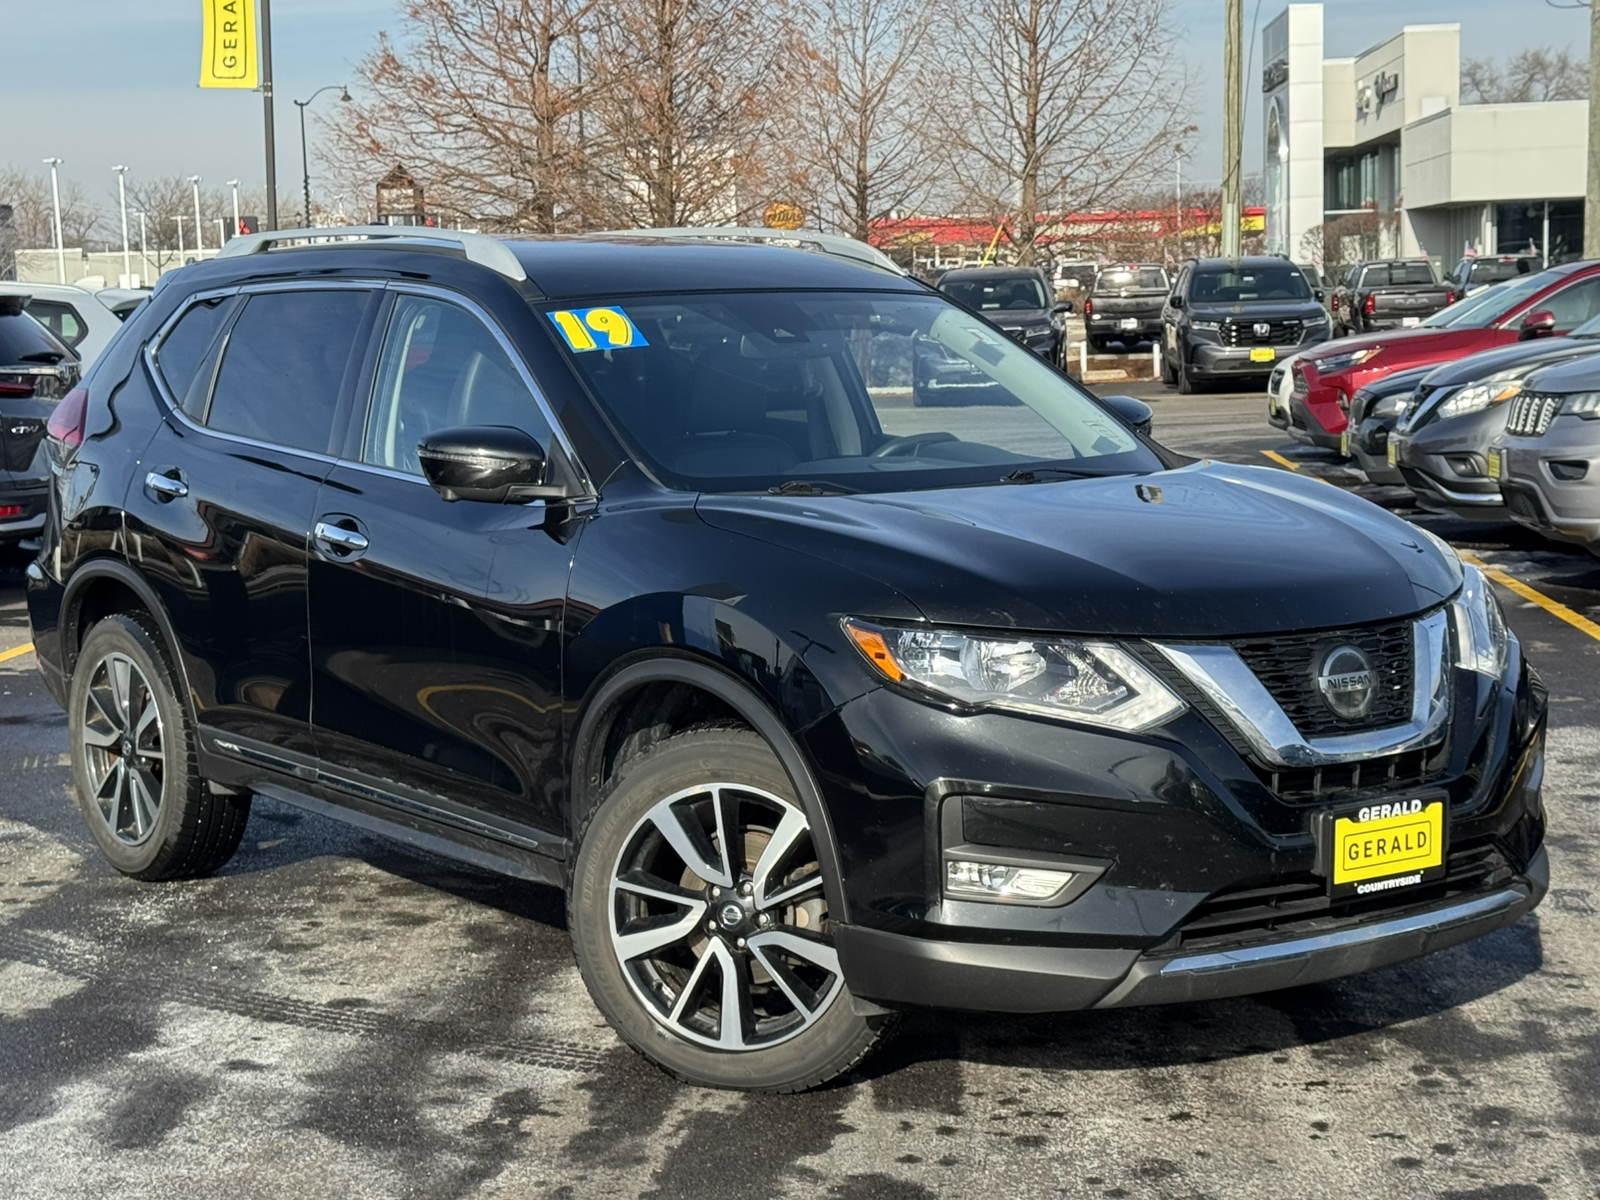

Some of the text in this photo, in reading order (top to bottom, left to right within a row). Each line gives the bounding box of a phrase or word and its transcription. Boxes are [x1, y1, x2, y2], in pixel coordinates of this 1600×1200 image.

[222, 0, 238, 69] GERA
[554, 308, 632, 349] 19
[1327, 674, 1372, 689] NISSAN
[1358, 800, 1422, 823] GERALD
[1348, 831, 1427, 861] GERALD
[583, 834, 606, 902] DEFENDER
[1357, 874, 1421, 894] COUNTRYSIDE
